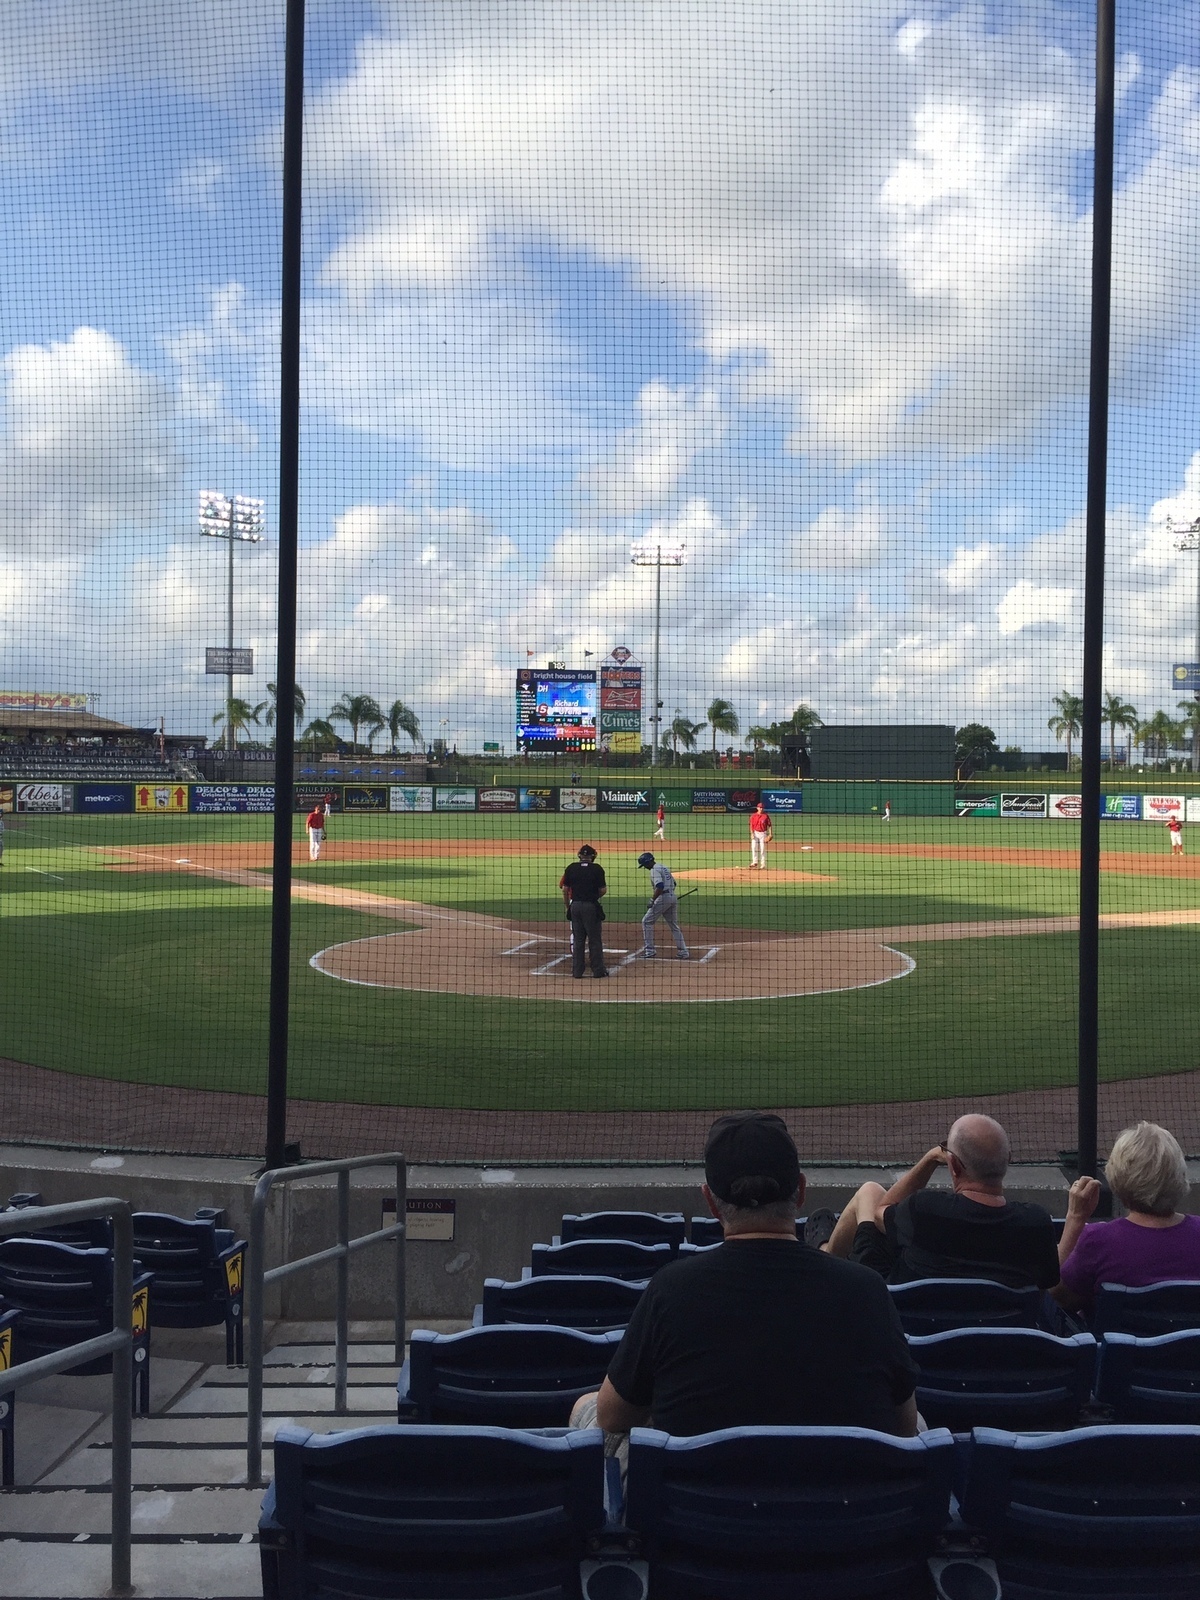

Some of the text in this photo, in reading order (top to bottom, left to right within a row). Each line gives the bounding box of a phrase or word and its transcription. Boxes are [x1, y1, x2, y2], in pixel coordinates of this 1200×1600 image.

[602, 671, 640, 680] HOOTERS
[602, 713, 640, 727] Times
[18, 784, 61, 800] Abe's
[602, 790, 648, 805] MaintenX
